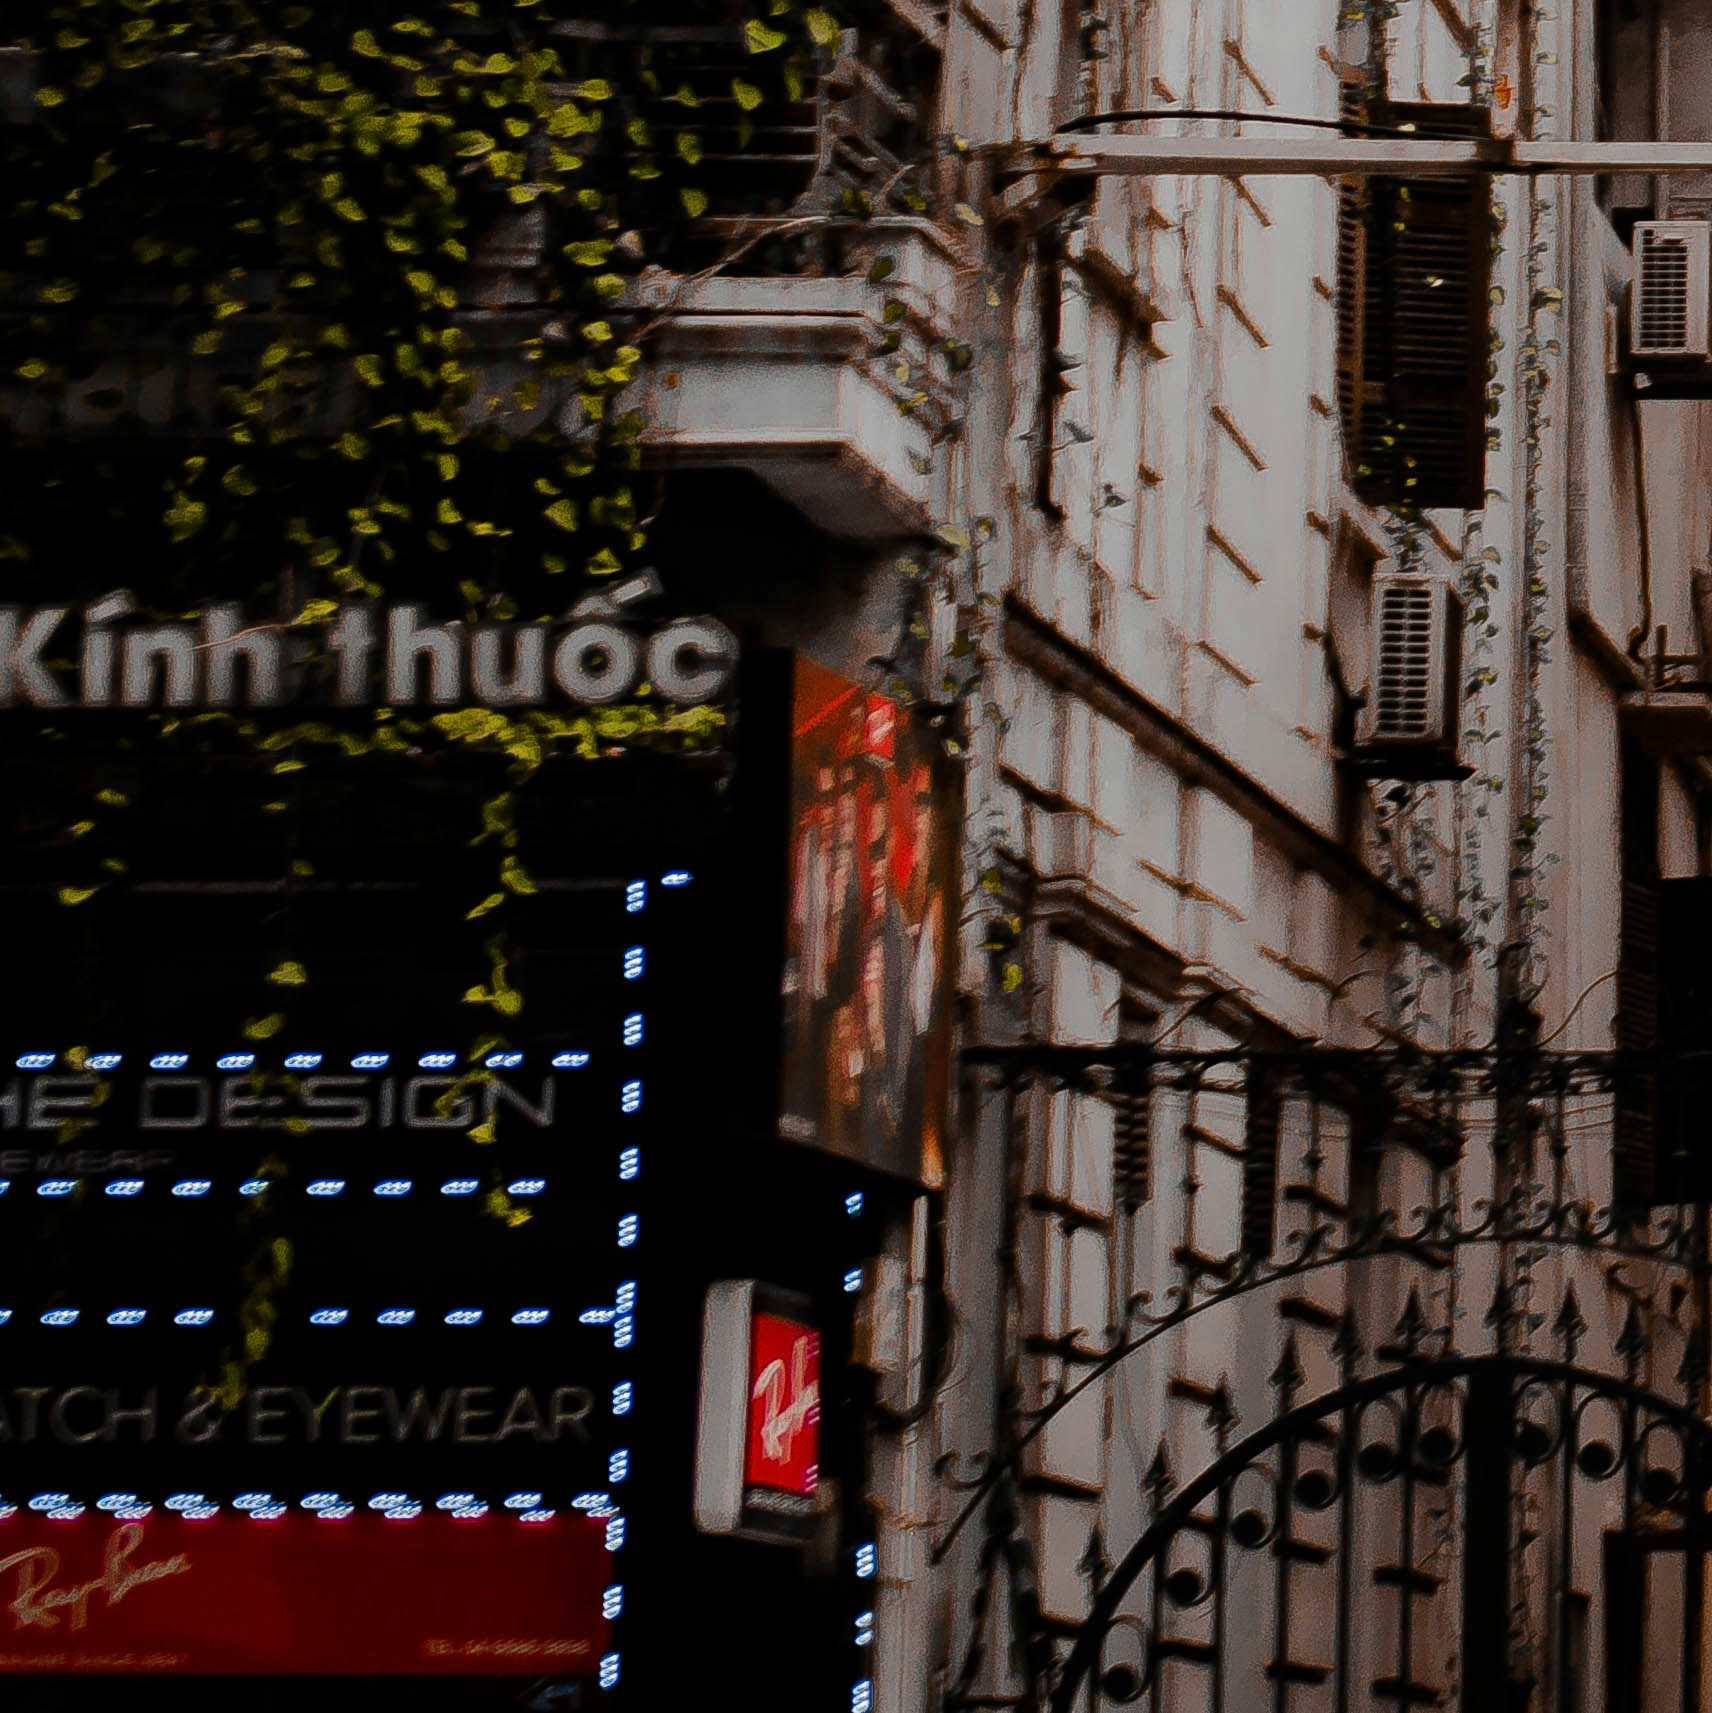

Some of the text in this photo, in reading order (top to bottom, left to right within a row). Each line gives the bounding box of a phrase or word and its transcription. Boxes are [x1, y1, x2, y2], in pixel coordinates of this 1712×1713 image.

[0, 566, 742, 708] Kính thuốc
[137, 1074, 558, 1130] DESIGN
[174, 1385, 222, 1445] &
[244, 1385, 595, 1445] EYEWEAR
